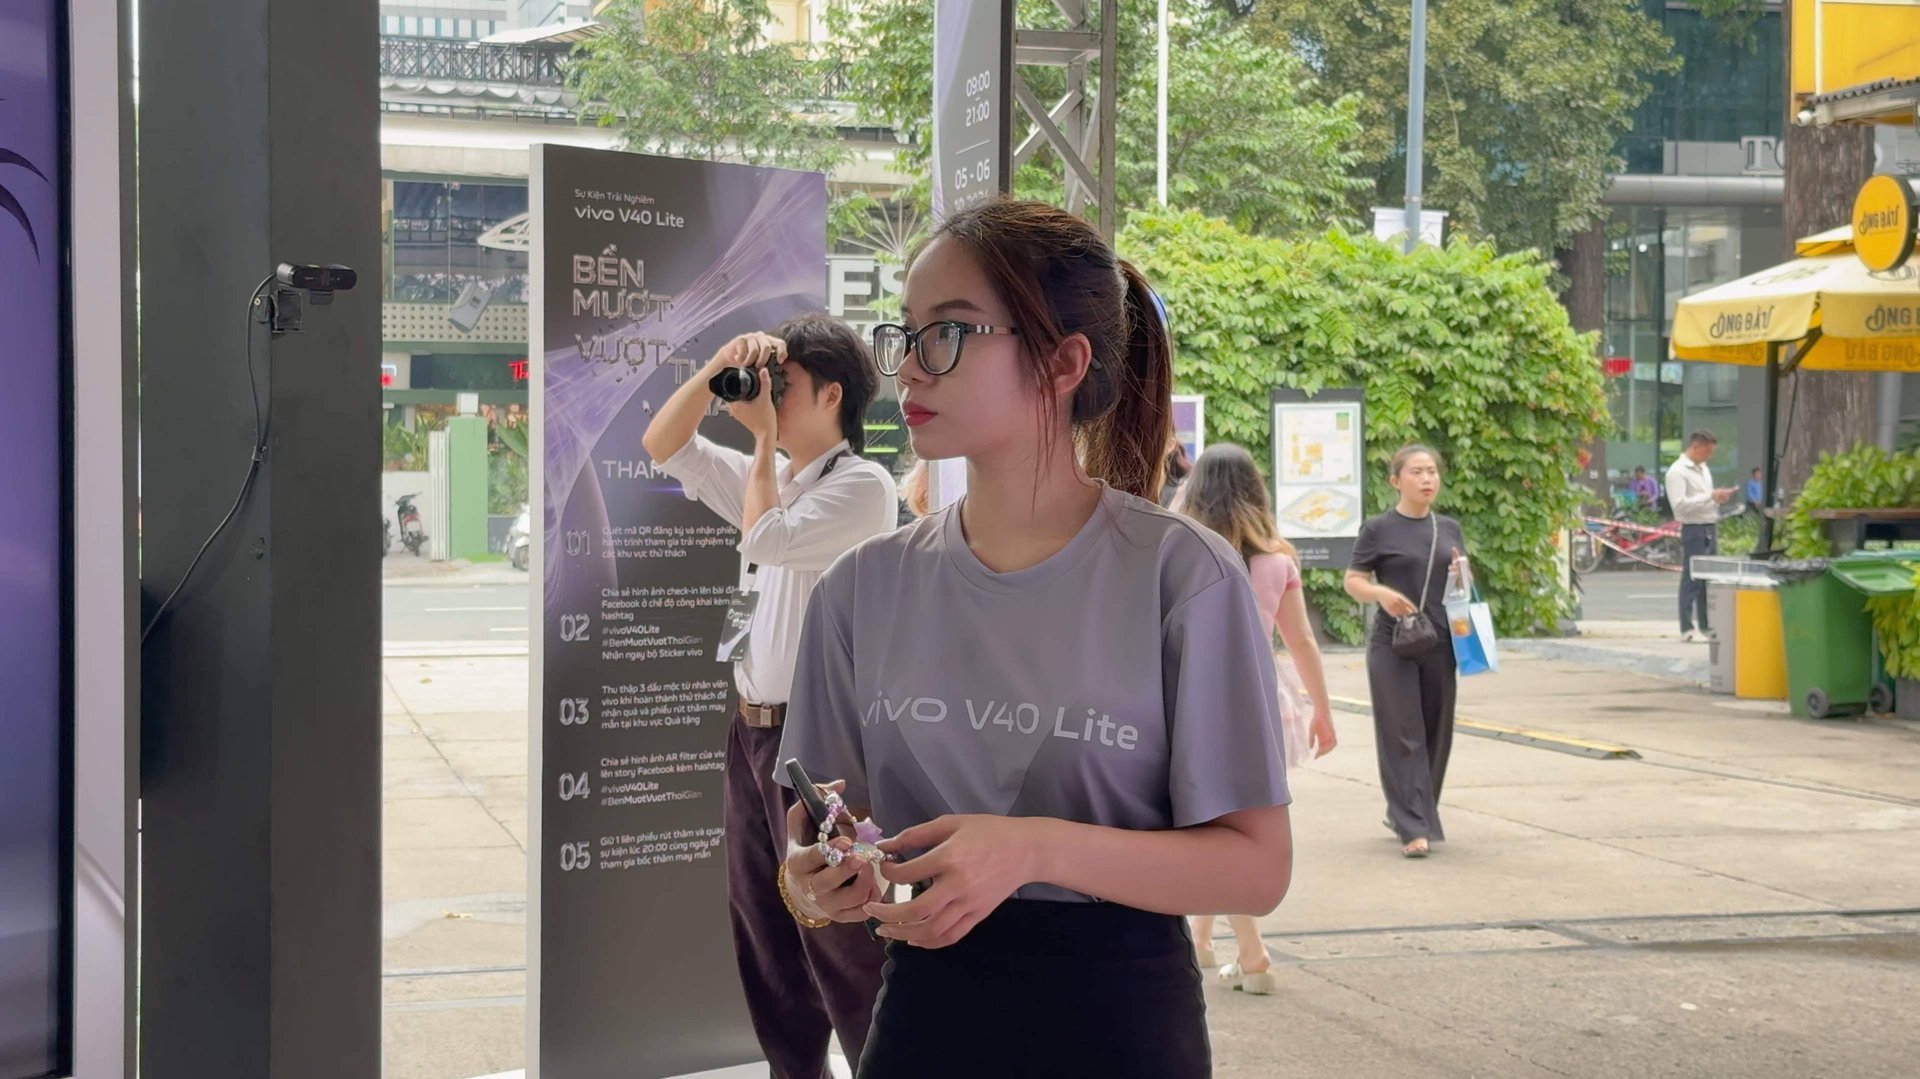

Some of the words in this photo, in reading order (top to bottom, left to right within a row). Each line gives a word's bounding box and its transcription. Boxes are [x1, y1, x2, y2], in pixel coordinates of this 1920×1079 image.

[966, 70, 990, 97] 09:00
[966, 100, 990, 128] 21:00
[955, 167, 968, 190] 05
[977, 158, 990, 183] 06
[575, 205, 615, 222] vivo
[618, 208, 652, 225] V40
[656, 211, 685, 228] Lite
[1865, 303, 1912, 332] ÔNG
[567, 529, 591, 556] 01
[666, 586, 698, 596] check-in
[602, 599, 640, 609] Facebook
[602, 611, 634, 622] hashtag
[560, 613, 590, 642] 02
[602, 624, 660, 635] #vivoV40Lite
[659, 648, 686, 658] Sticker
[687, 648, 703, 657] vivo
[601, 685, 618, 694] Thu
[640, 683, 646, 693] 3
[602, 697, 619, 706] vivo
[559, 698, 590, 727] 03
[860, 690, 948, 728] vivo
[965, 698, 1040, 734] V40
[1053, 706, 1139, 750] Lite
[665, 752, 678, 762] AR
[679, 751, 698, 761] filter
[614, 768, 636, 779] story
[637, 764, 675, 776] Facebook
[694, 760, 726, 772] hashtag
[559, 771, 590, 801] 04
[601, 781, 659, 794] #vivoV40Lite
[706, 827, 725, 837] quay
[560, 841, 591, 871] 05
[642, 842, 668, 854] 20:00
[675, 853, 693, 863] may
